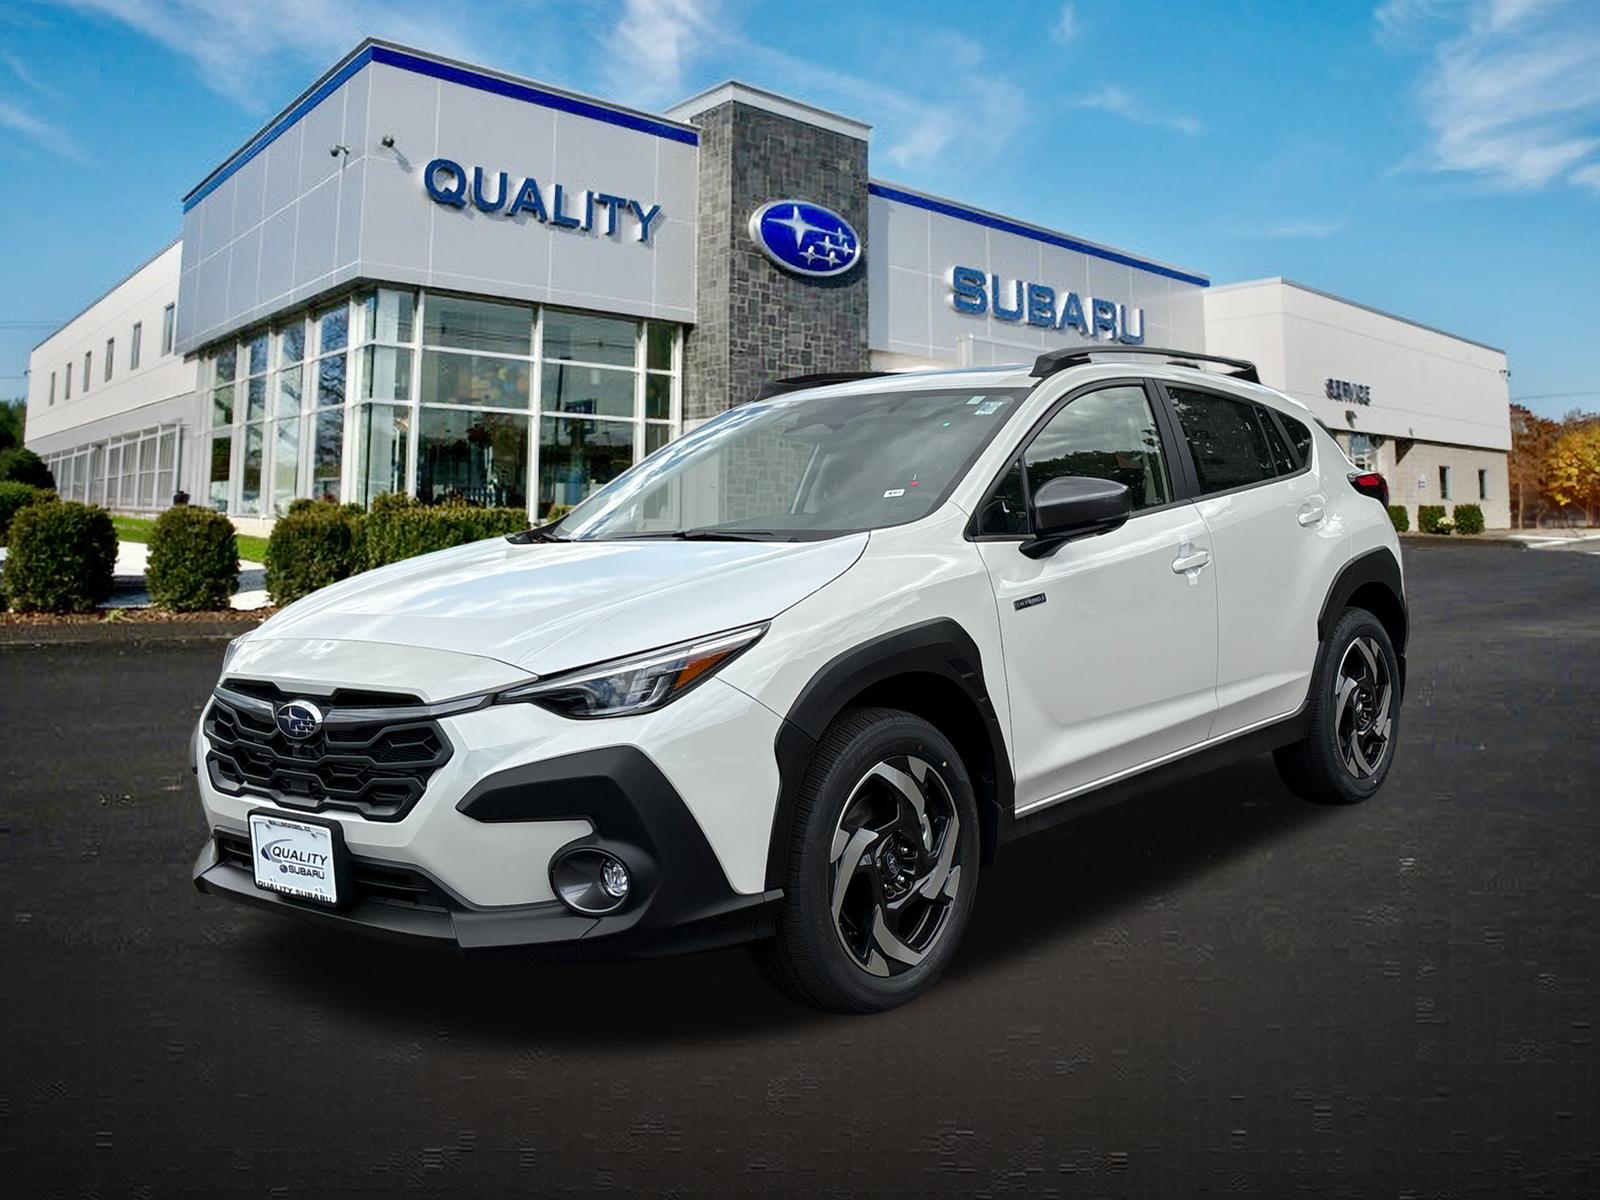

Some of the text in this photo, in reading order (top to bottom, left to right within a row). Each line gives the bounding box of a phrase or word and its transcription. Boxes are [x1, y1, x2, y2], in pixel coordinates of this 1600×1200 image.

[424, 158, 661, 242] QUALITY
[950, 265, 1145, 346] SUBARU
[1325, 378, 1371, 406] SERVICE
[272, 846, 328, 866] QUALITY
[288, 865, 325, 879] SUBARU
[257, 880, 332, 902] QUALITY SUBARU
